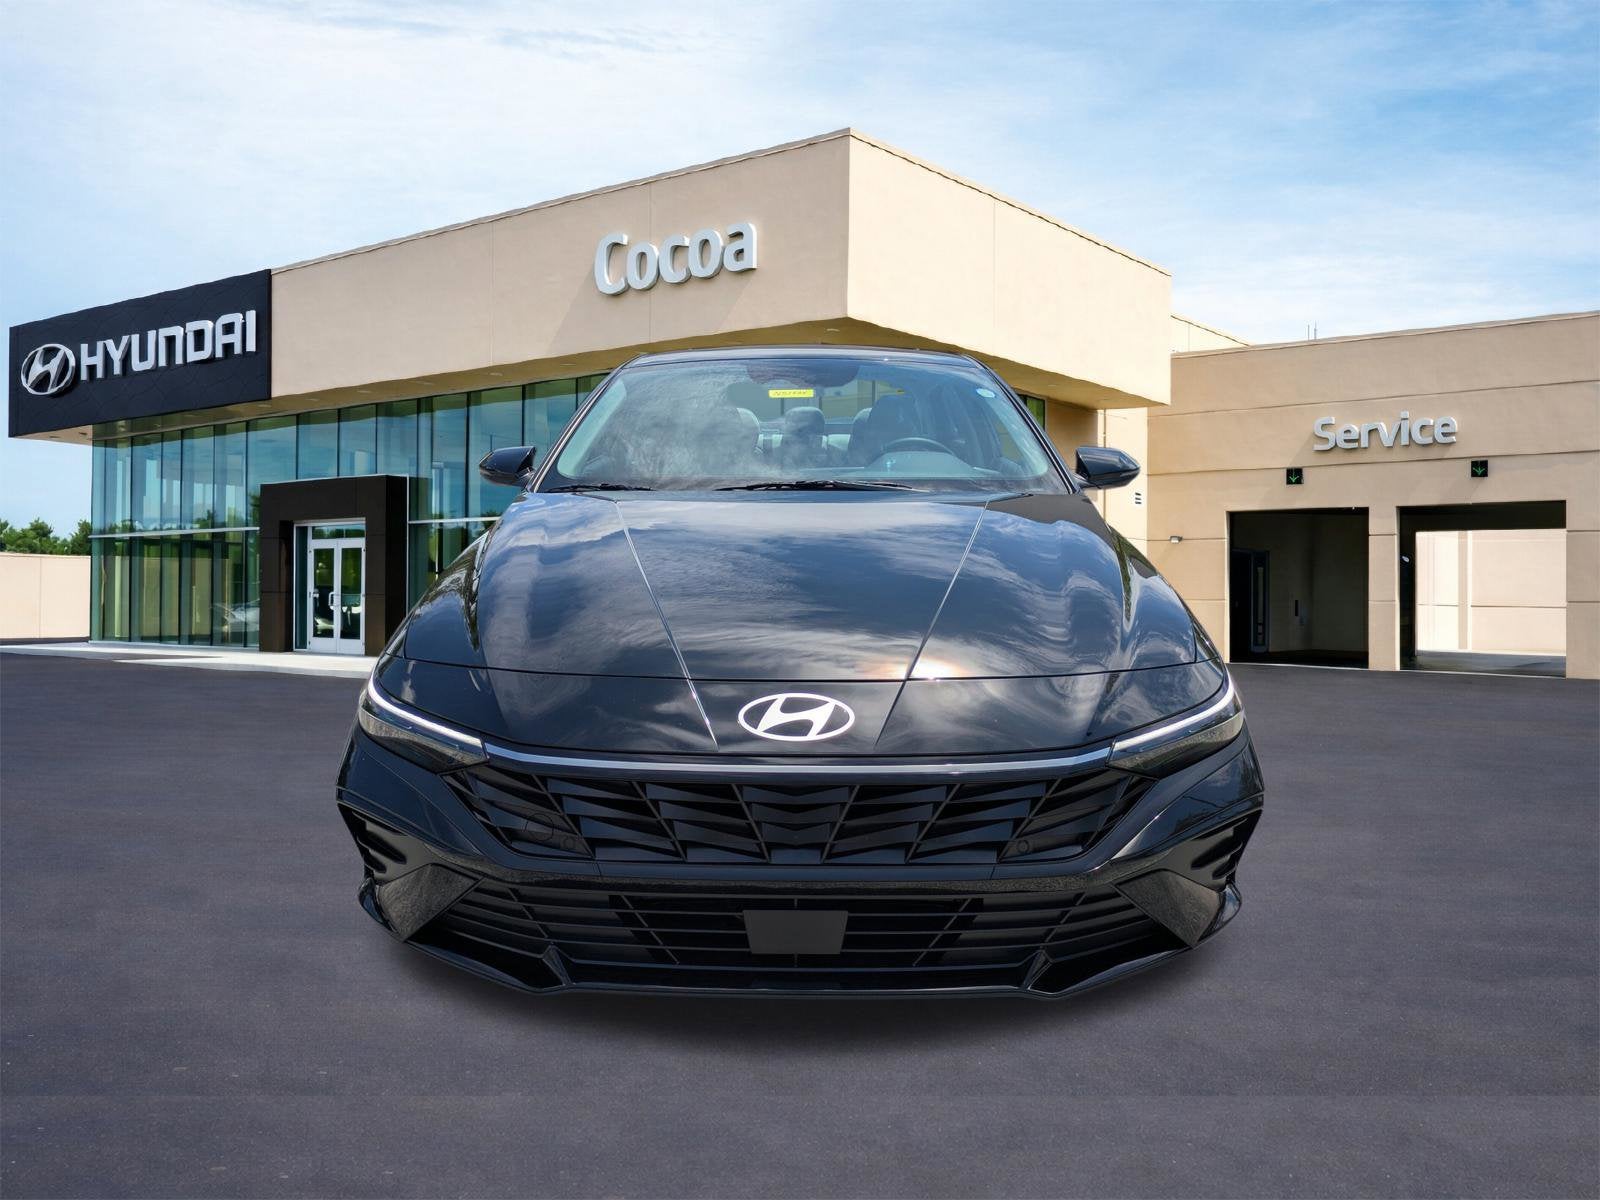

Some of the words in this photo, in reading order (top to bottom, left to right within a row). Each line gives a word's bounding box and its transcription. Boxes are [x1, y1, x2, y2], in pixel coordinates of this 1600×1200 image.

[594, 222, 758, 296] Cocoa
[80, 310, 256, 381] HYUNDAI
[1312, 411, 1458, 452] Service
